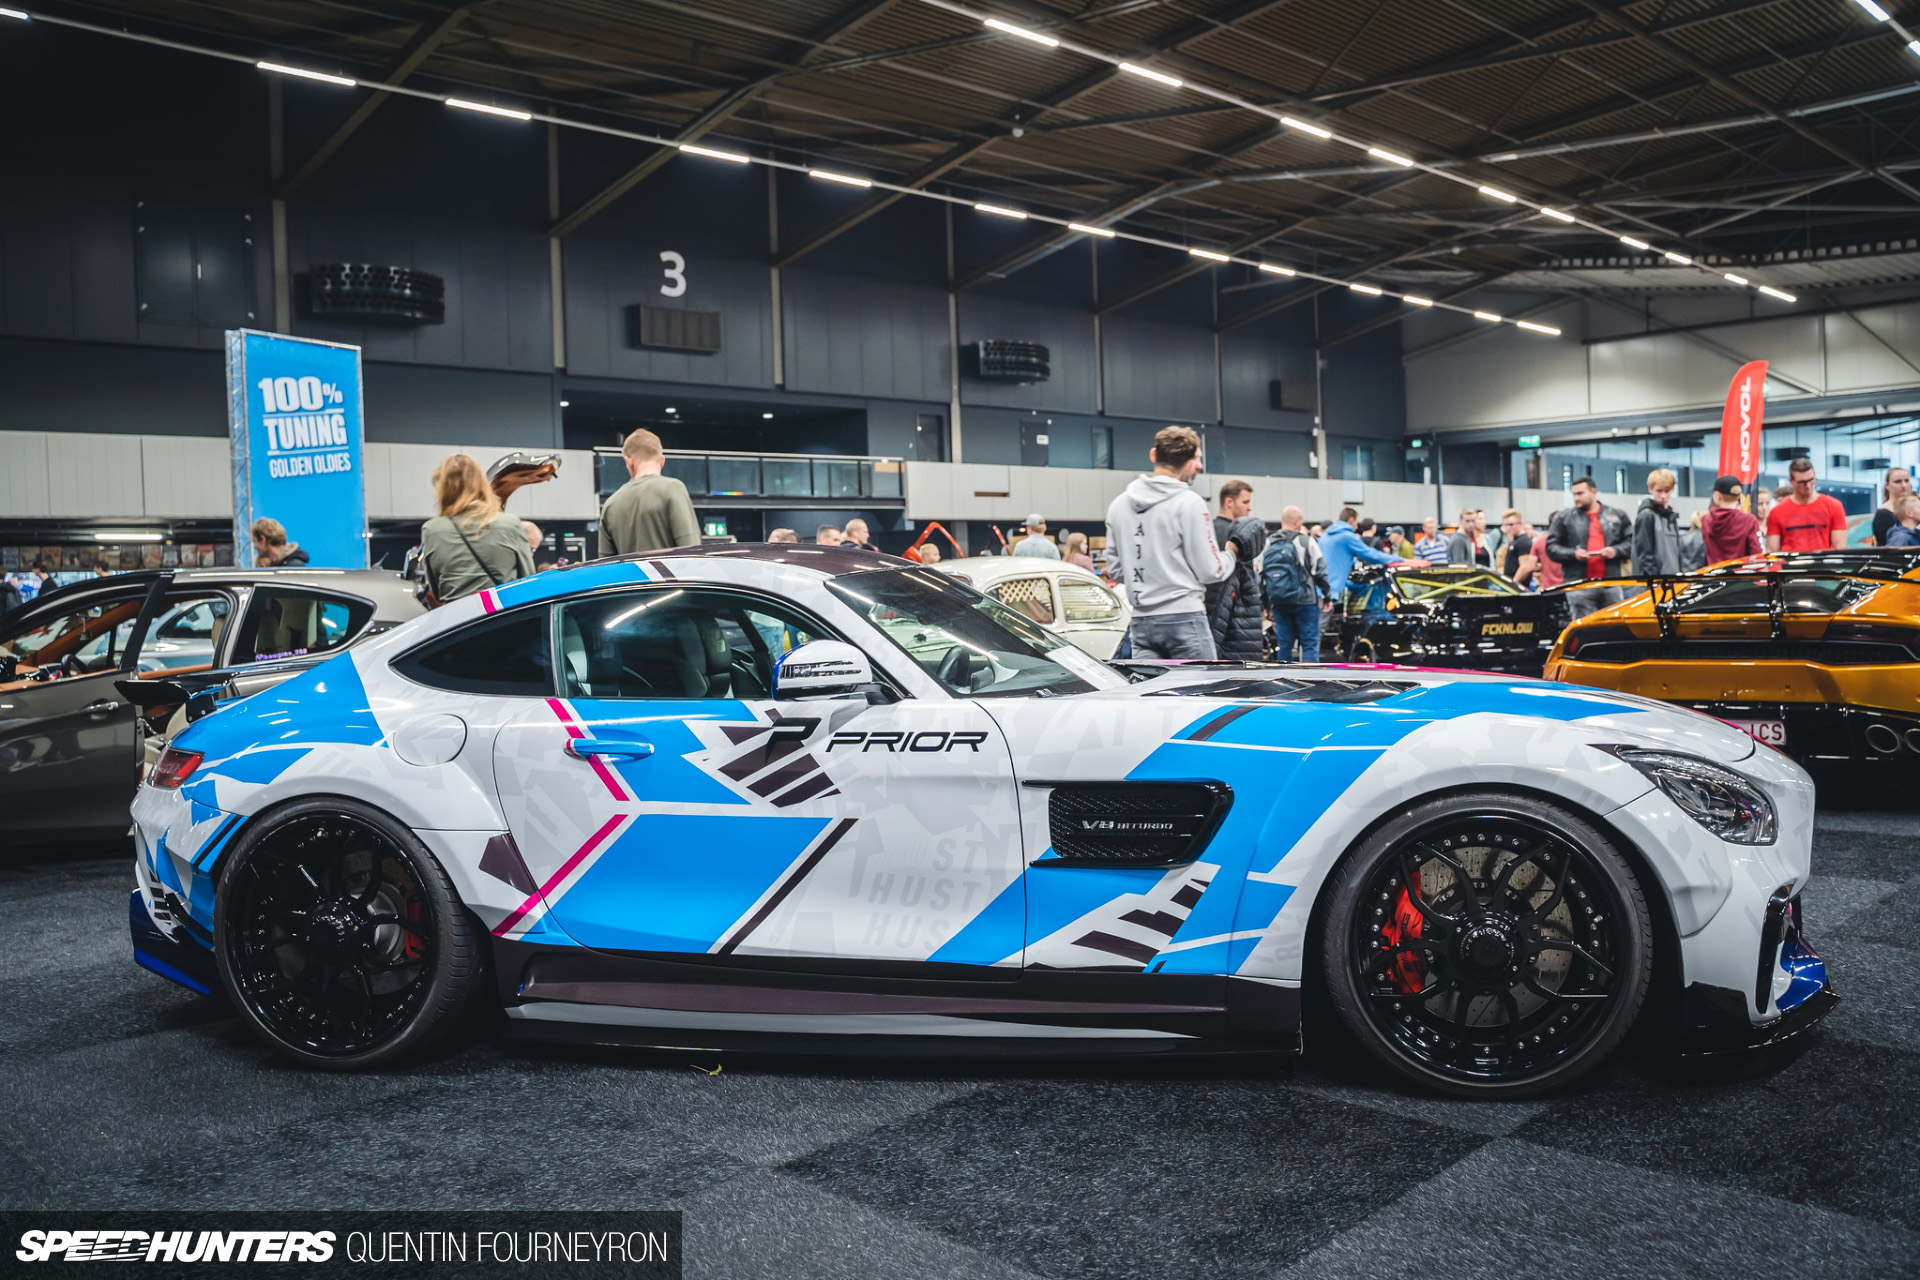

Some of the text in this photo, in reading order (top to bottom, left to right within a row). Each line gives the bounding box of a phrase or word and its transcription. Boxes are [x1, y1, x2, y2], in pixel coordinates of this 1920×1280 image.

[659, 250, 687, 297] 3
[257, 376, 344, 413] 100%
[262, 414, 348, 451] TUNING
[1740, 376, 1751, 472] NOVOL
[268, 452, 352, 479] GOLDEN OLDIES
[1481, 622, 1534, 636] FCKNLOW
[825, 731, 989, 753] PRIOR
[1082, 820, 1173, 830] V8 BITURBO
